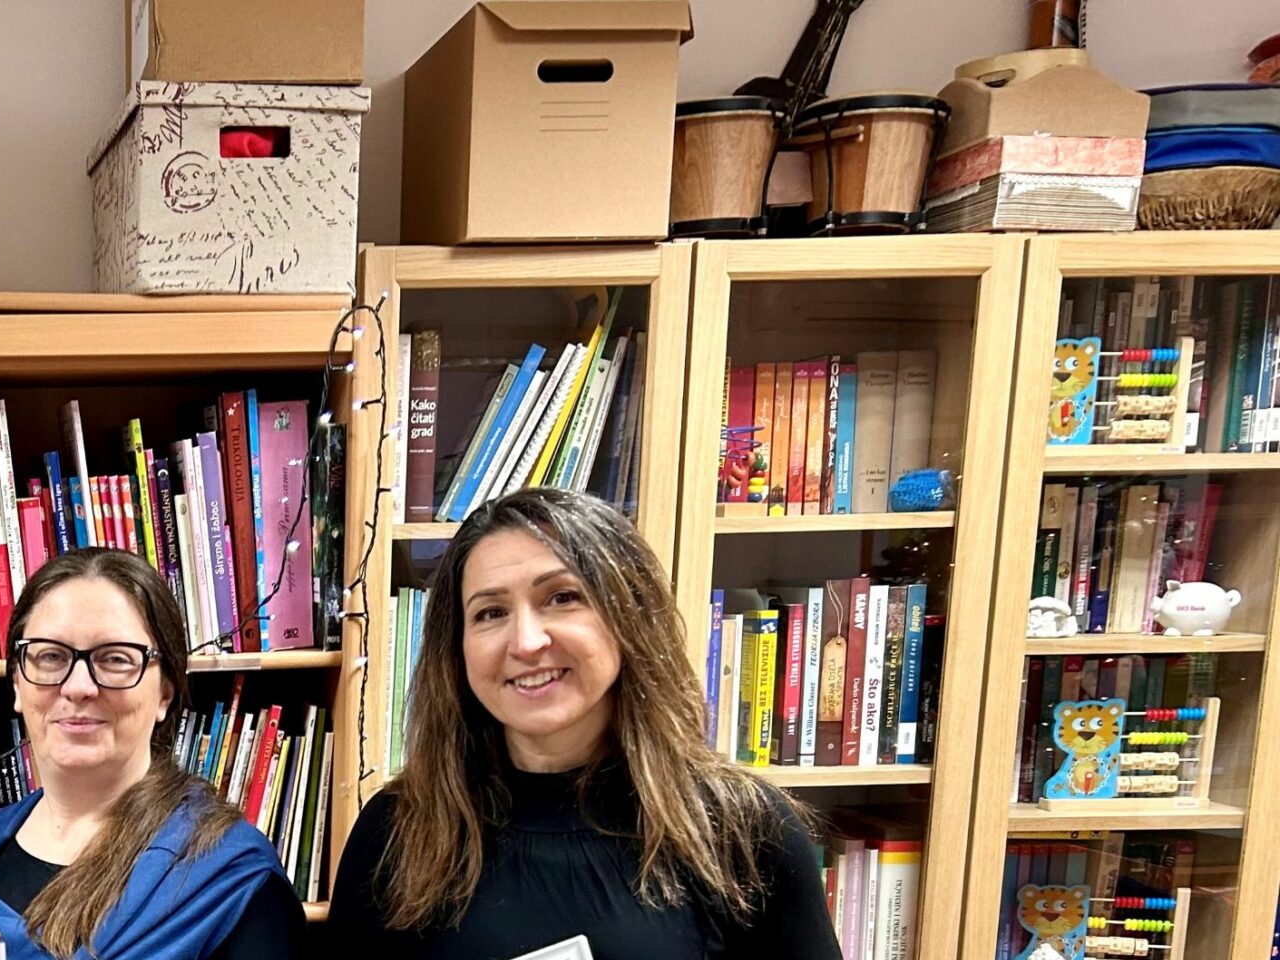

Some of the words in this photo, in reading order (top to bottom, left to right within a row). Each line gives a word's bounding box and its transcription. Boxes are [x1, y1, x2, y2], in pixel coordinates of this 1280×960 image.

[410, 398, 436, 410] Kako
[410, 412, 434, 423] čitati
[410, 425, 433, 438] grad
[230, 425, 243, 502] TRIKOLOGIJA
[251, 474, 262, 519] majstorije
[160, 488, 175, 543] FANTASTIČNA
[209, 500, 220, 532] žabac
[167, 543, 177, 563] BIĆA
[213, 540, 225, 575] Sirena
[853, 592, 865, 629] KAMOV
[909, 605, 922, 632] obitelj
[790, 618, 801, 661] STVARNOSTI
[809, 634, 819, 666] TEORIJA
[909, 638, 917, 656] tony
[760, 639, 769, 686] TELEVIZIJE
[888, 644, 897, 668] PRIČE
[789, 662, 799, 687] TEŽINA
[852, 677, 860, 697] Darko
[907, 659, 916, 691] parsons
[807, 681, 816, 707] Glasser
[867, 678, 880, 699] Što
[884, 670, 896, 727] ISCJELJUJUĆE
[805, 708, 814, 735] William
[865, 702, 876, 731] ako?
[893, 878, 902, 912] NJEMAČKI
[892, 918, 900, 940] SRPSKI
[899, 925, 907, 952] RJEČNIK
